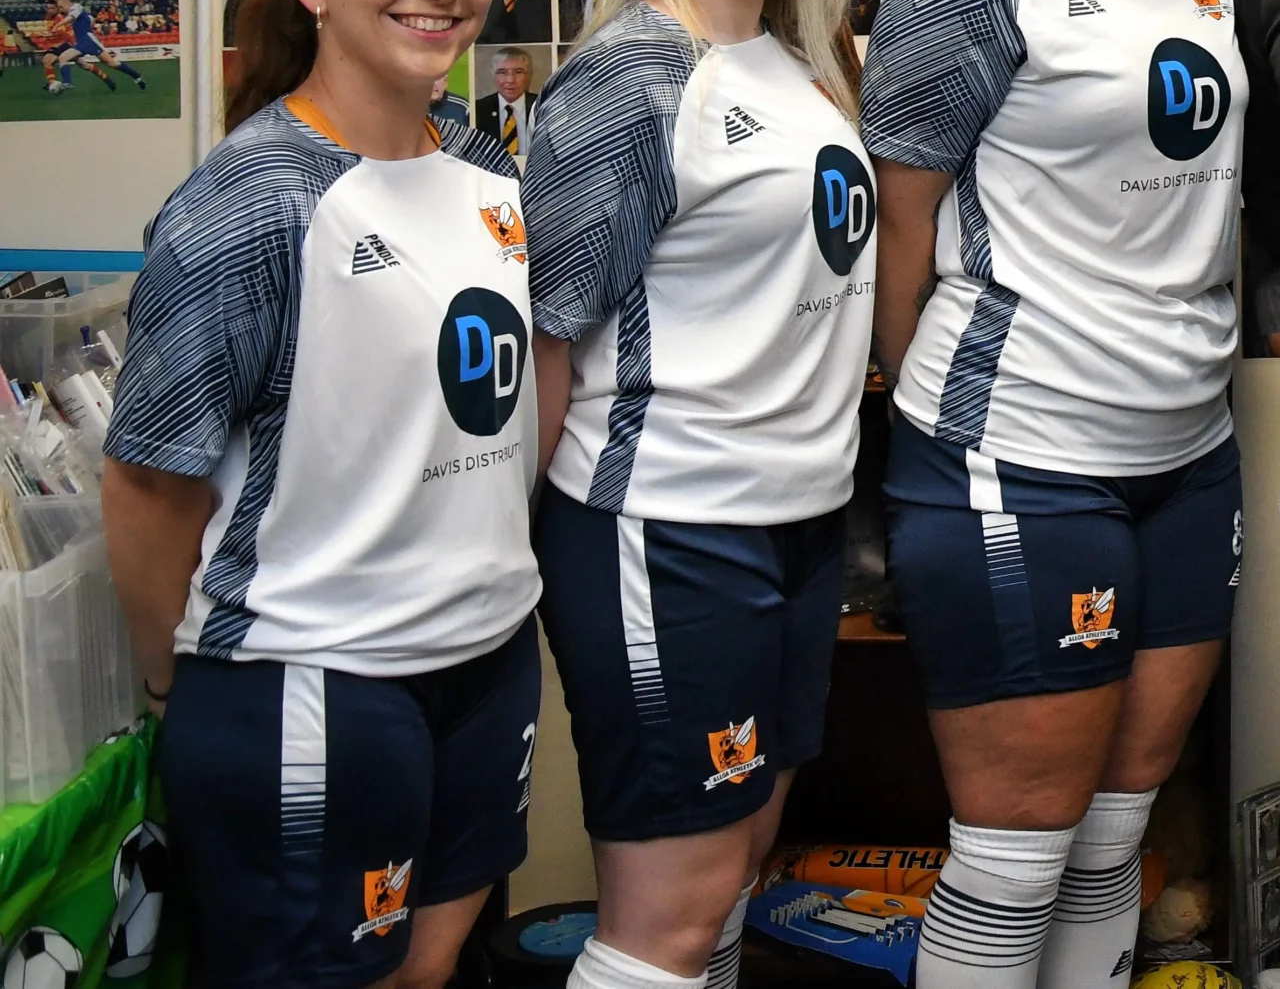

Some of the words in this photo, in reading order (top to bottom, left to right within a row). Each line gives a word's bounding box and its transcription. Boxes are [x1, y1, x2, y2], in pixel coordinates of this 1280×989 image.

[728, 105, 766, 134] PENDLE
[1120, 178, 1160, 192] DAVIS
[1163, 167, 1238, 188] DISTRIBUTION
[364, 233, 401, 268] PENDLE
[796, 296, 832, 317] DAVIS
[422, 459, 461, 483] DAVIS
[516, 722, 536, 782] 2
